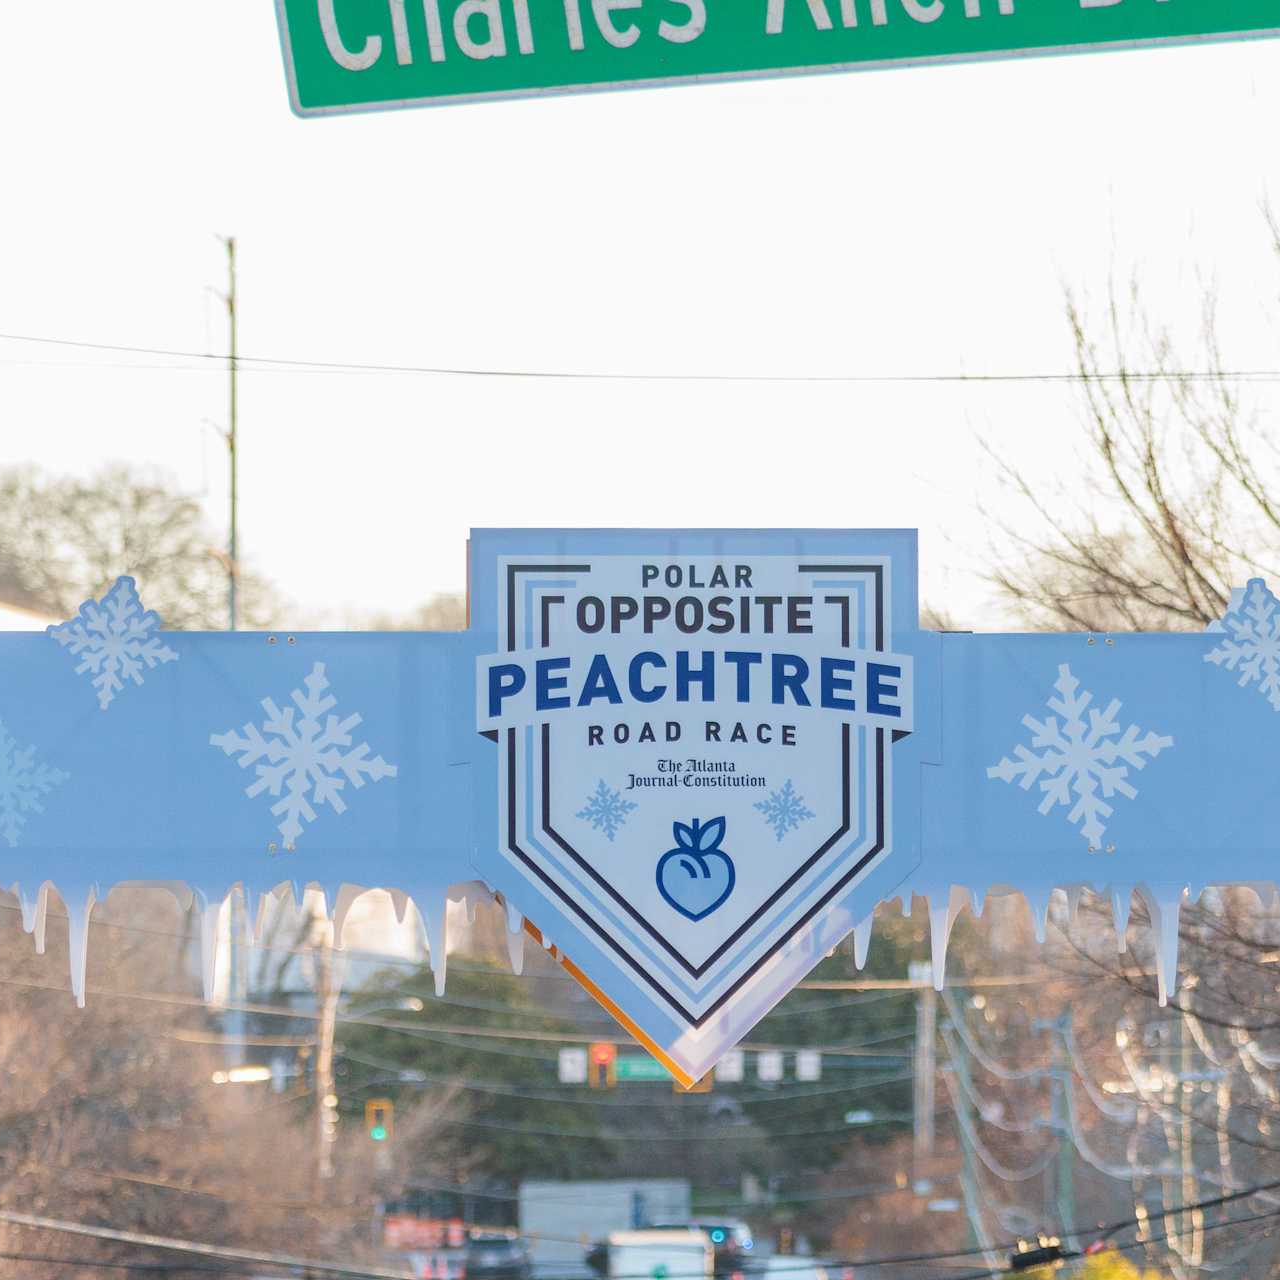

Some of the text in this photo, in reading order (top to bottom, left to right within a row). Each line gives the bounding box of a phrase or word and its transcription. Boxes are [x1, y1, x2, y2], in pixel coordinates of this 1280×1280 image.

[641, 564, 754, 589] POLAR
[575, 595, 814, 635] OPPOSITE
[488, 649, 902, 718] PEACHTREE
[588, 721, 798, 747] ROAD RACE
[657, 758, 737, 774] The Atlanta
[625, 772, 767, 790] Journal-Constitution
